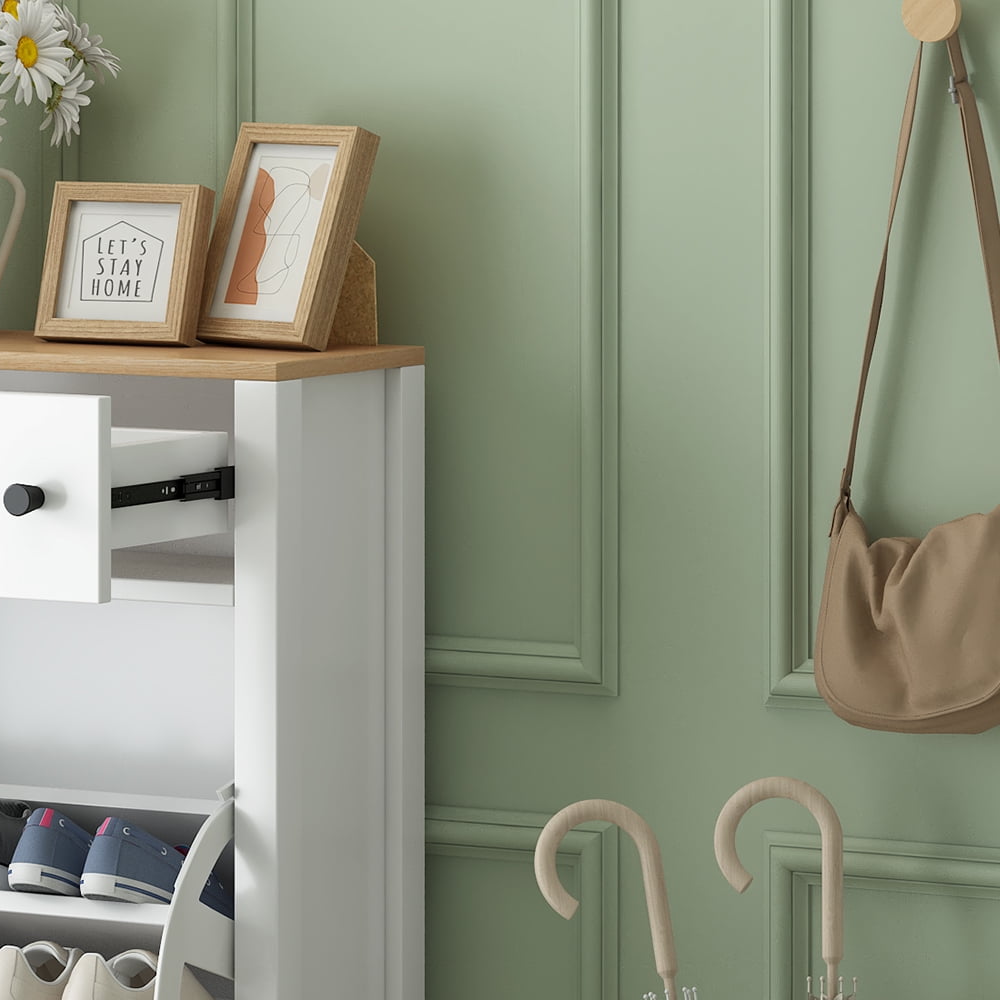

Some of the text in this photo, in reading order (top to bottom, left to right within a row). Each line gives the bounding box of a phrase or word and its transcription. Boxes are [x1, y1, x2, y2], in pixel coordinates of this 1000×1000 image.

[97, 236, 147, 255] LET'S
[96, 258, 142, 276] STAY
[91, 278, 141, 297] HOME
